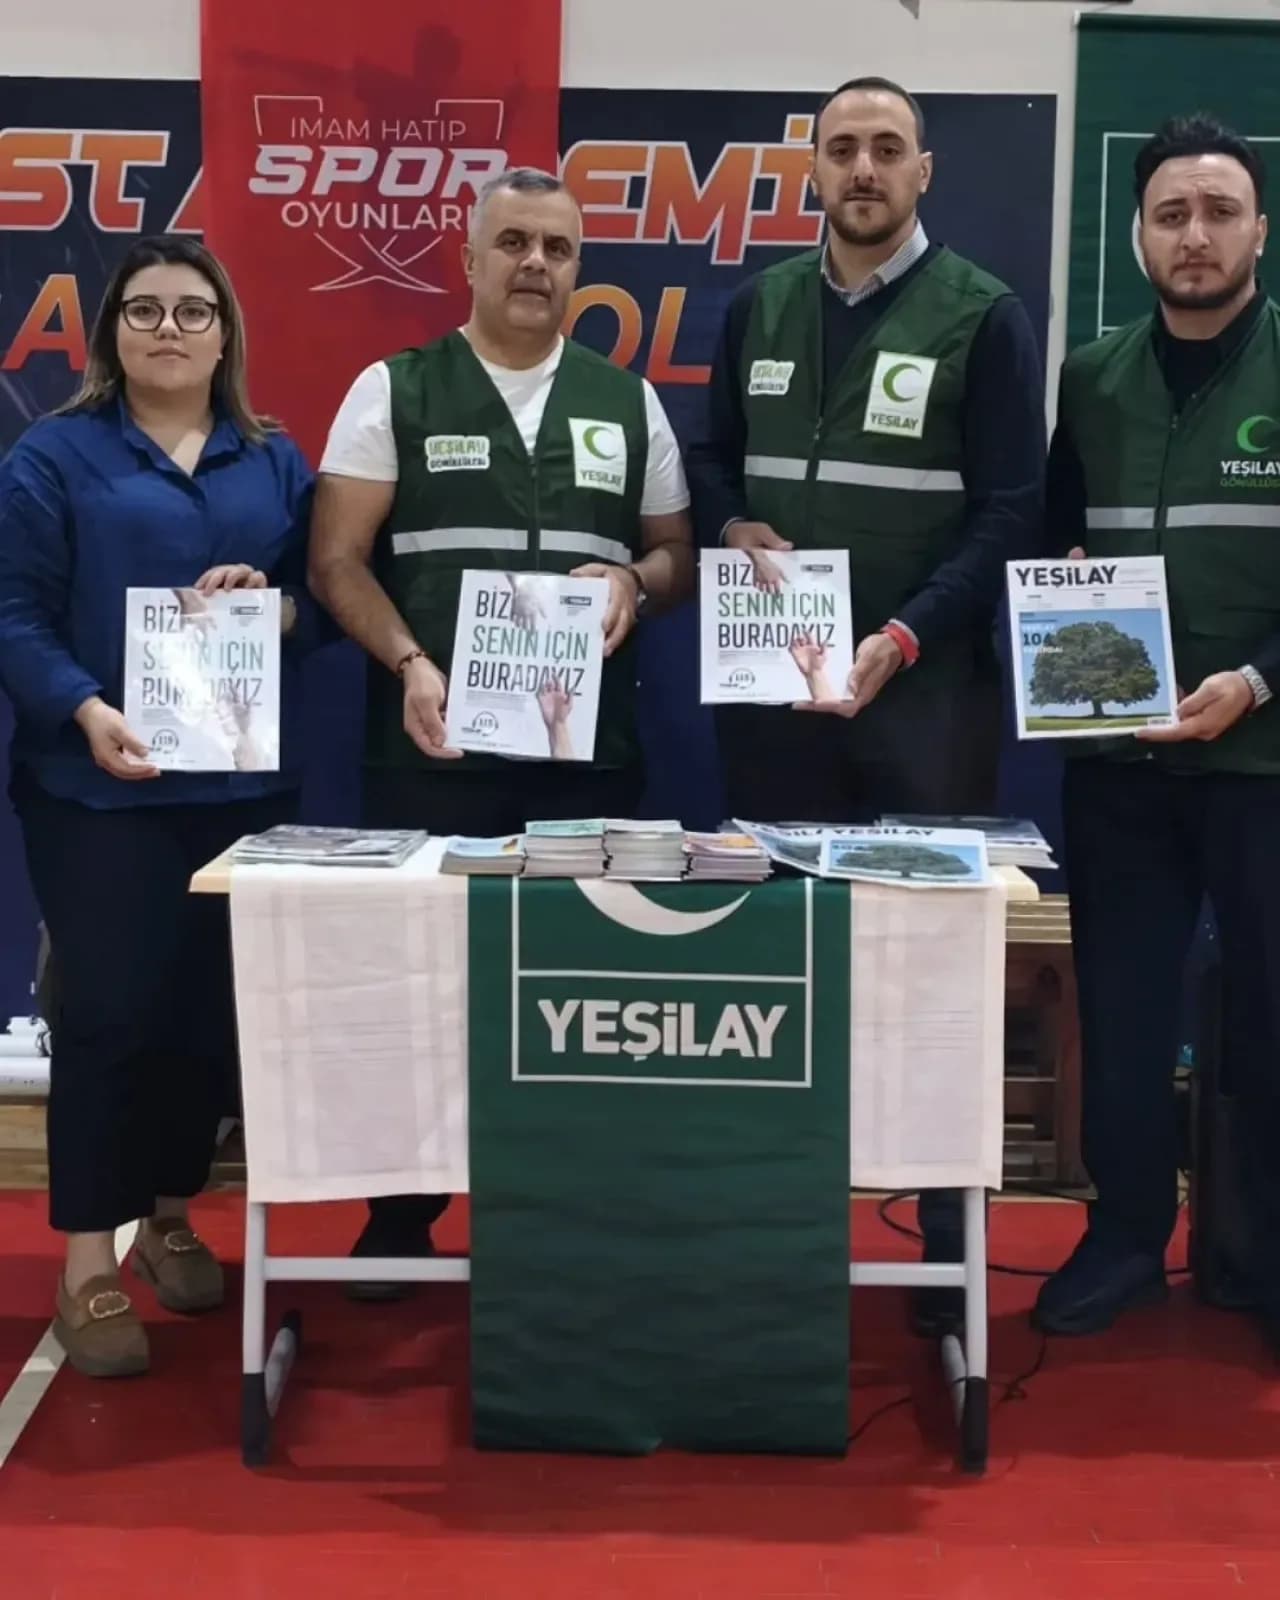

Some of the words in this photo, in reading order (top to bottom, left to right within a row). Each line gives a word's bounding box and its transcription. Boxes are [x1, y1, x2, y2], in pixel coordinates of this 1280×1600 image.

[248, 143, 508, 199] SPOR
[557, 114, 825, 265] EMİ
[281, 200, 473, 231] OYUNLARI
[718, 559, 751, 586] BİZ
[476, 587, 511, 619] BİZ
[718, 623, 835, 648] BURADAYIZ
[142, 677, 264, 706] BURDAYIZ
[467, 660, 585, 695] BURADAYIZ
